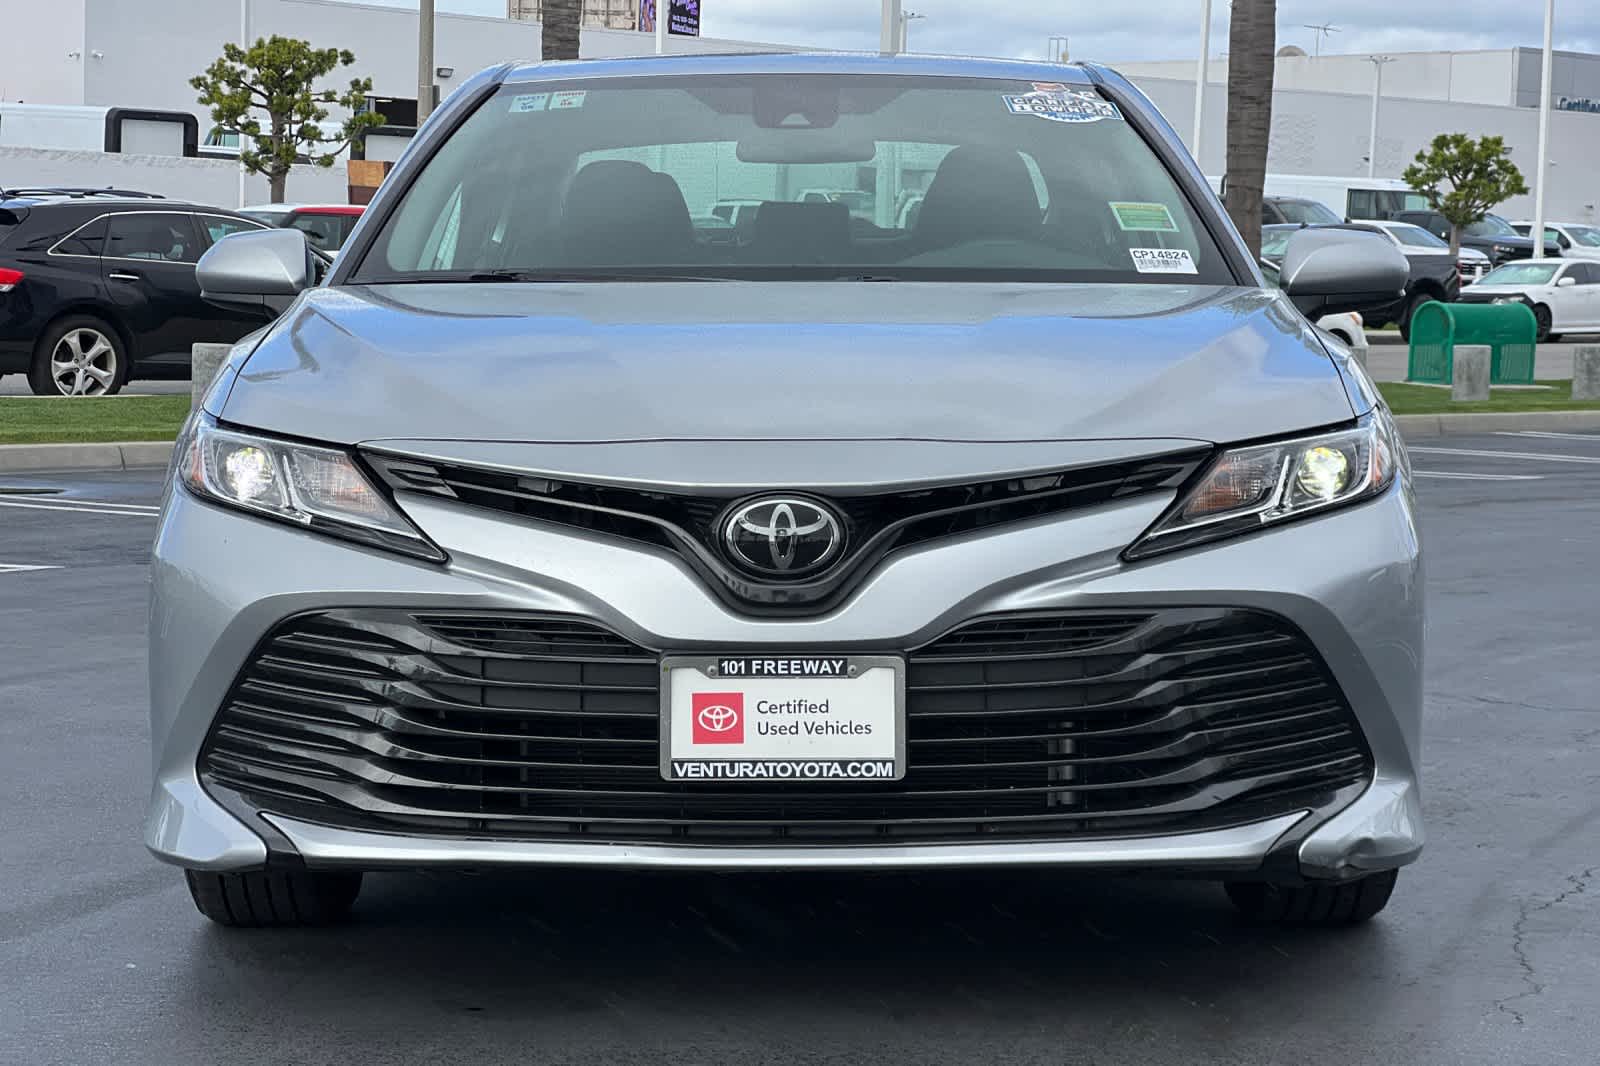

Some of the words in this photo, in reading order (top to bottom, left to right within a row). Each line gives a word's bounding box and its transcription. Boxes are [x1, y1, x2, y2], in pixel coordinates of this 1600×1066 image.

[1133, 250, 1189, 260] CP14824
[721, 660, 746, 675] 101
[752, 660, 844, 675] FREEWAY
[757, 699, 829, 714] Certified
[757, 721, 799, 736] Used
[803, 721, 872, 736] Vehicles
[674, 762, 893, 778] VENTURATOYOTA.COM
